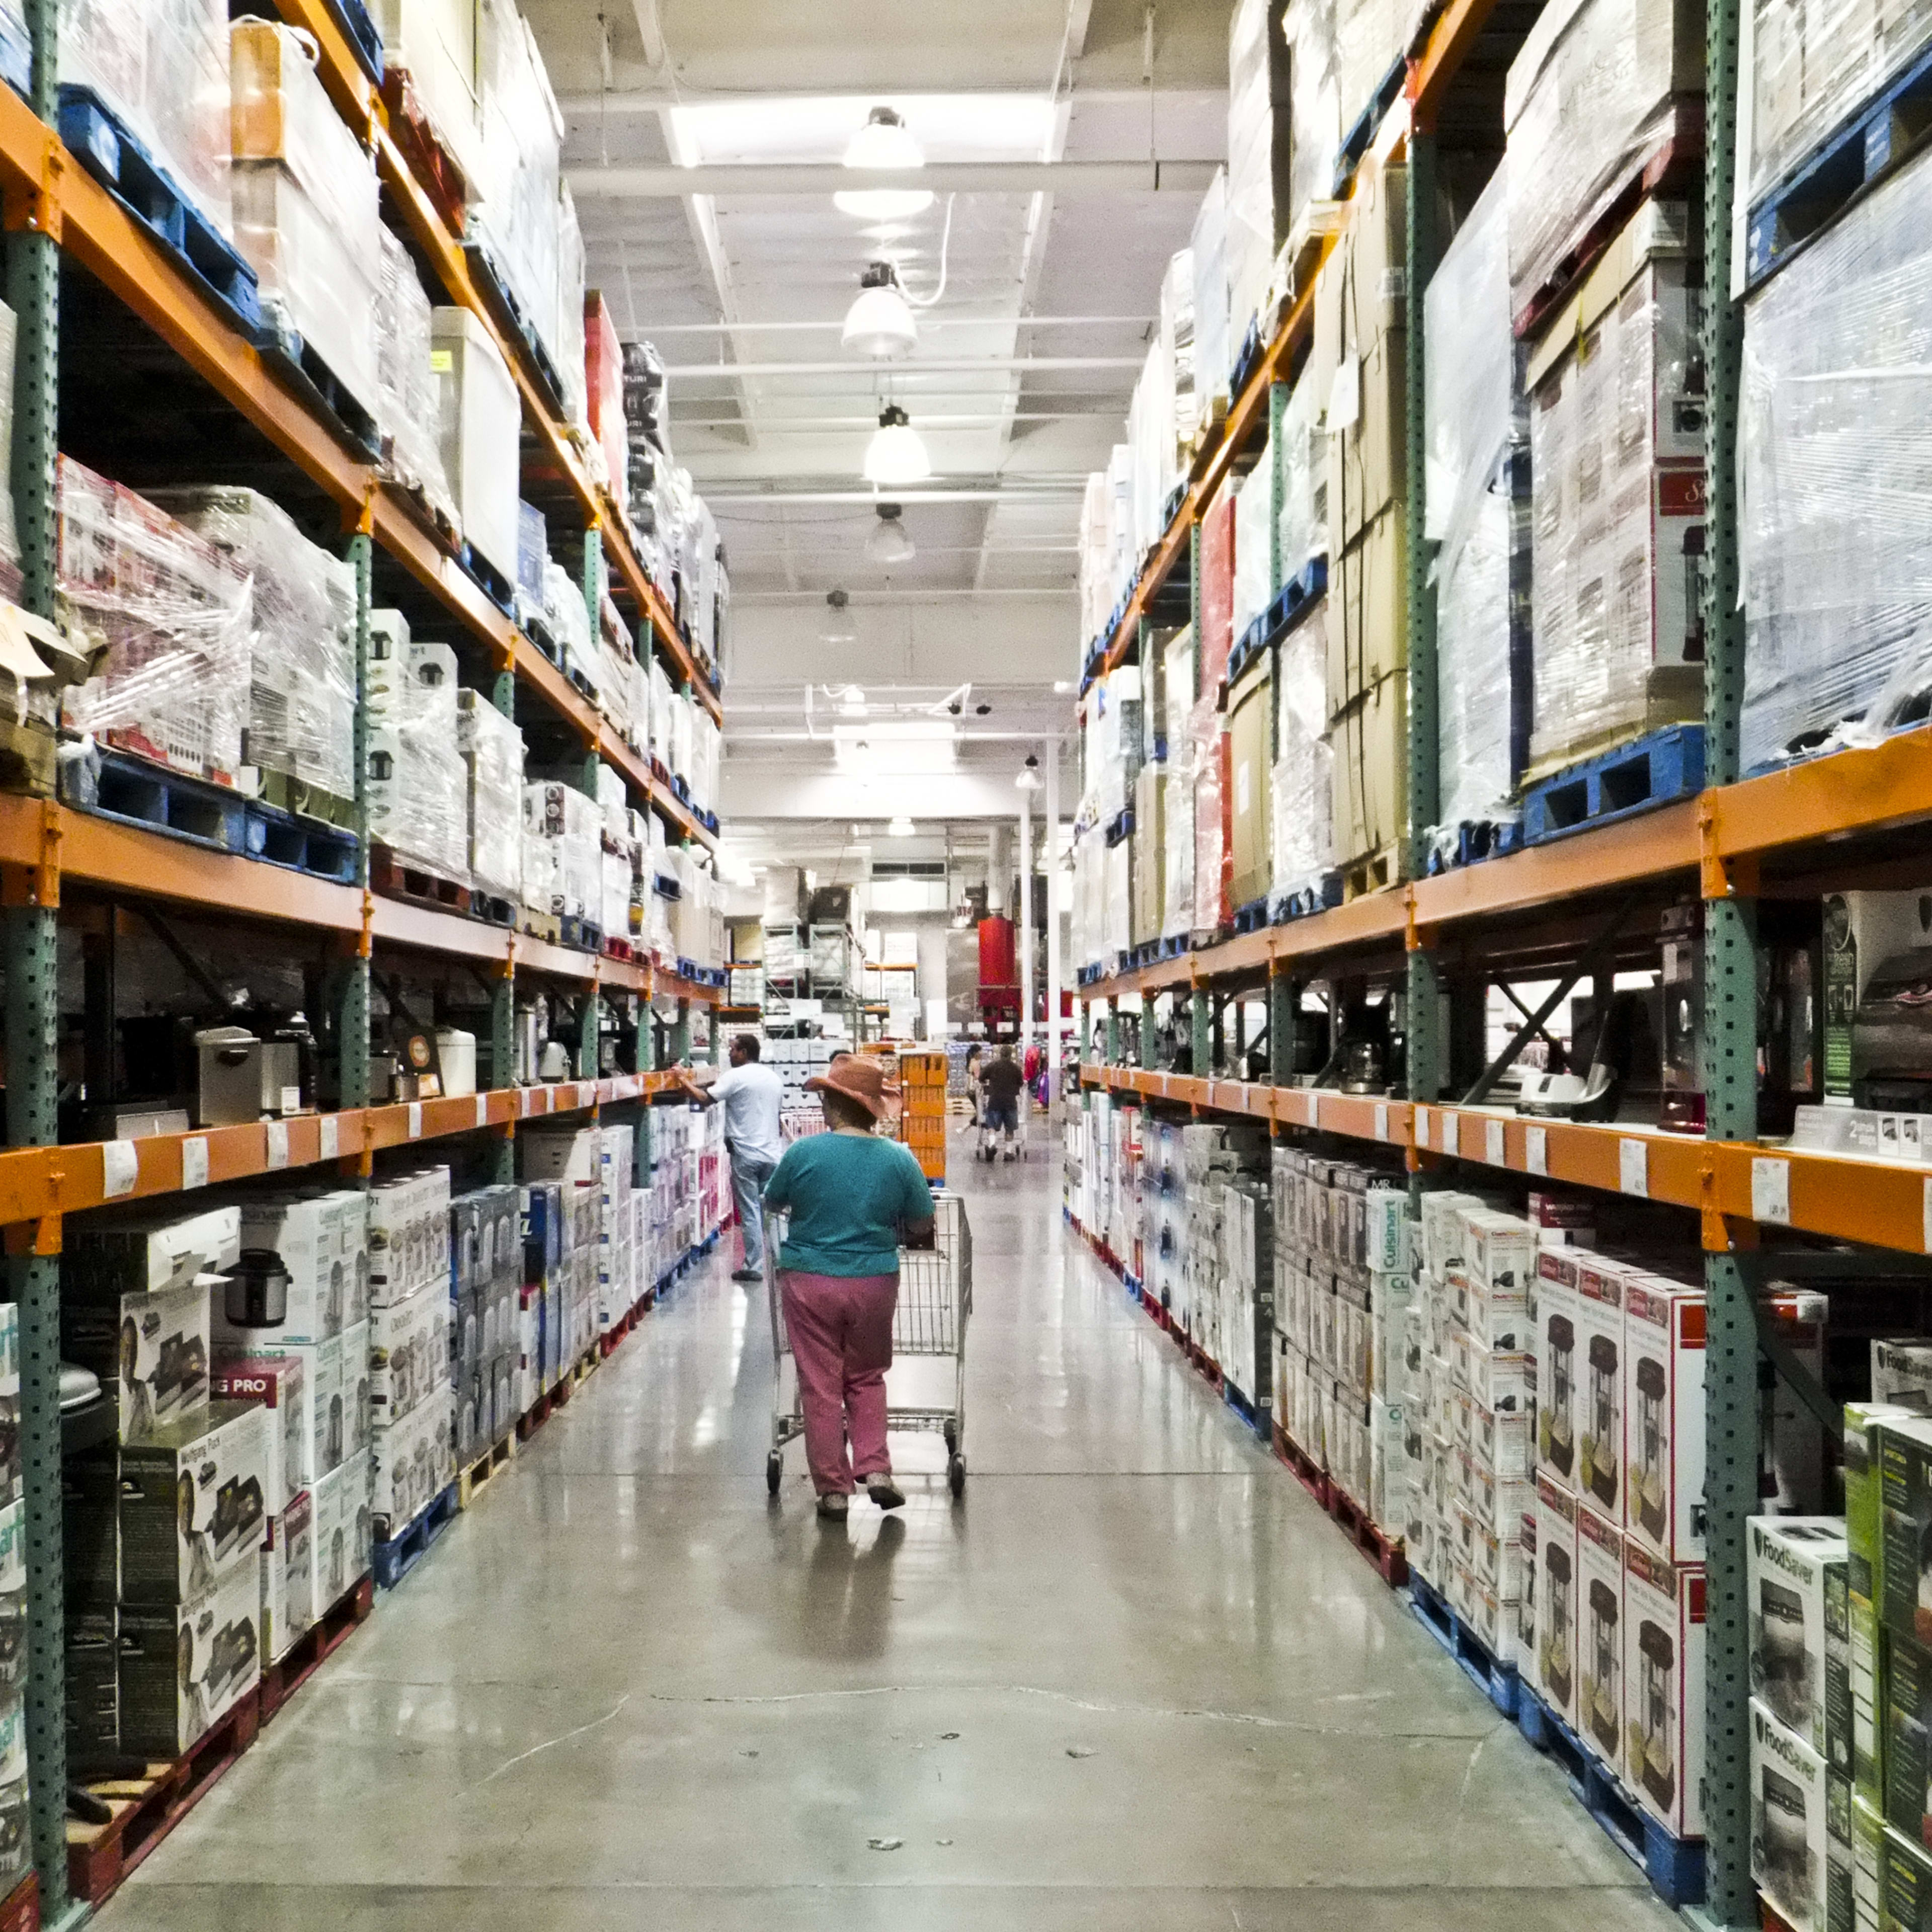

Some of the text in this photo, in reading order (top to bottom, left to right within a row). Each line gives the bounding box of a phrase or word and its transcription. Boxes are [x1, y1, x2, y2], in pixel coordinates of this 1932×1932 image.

[1385, 1200, 1396, 1268] Cuisinart
[233, 1379, 267, 1393] PRO
[1763, 1535, 1813, 1586] FoodSaver
